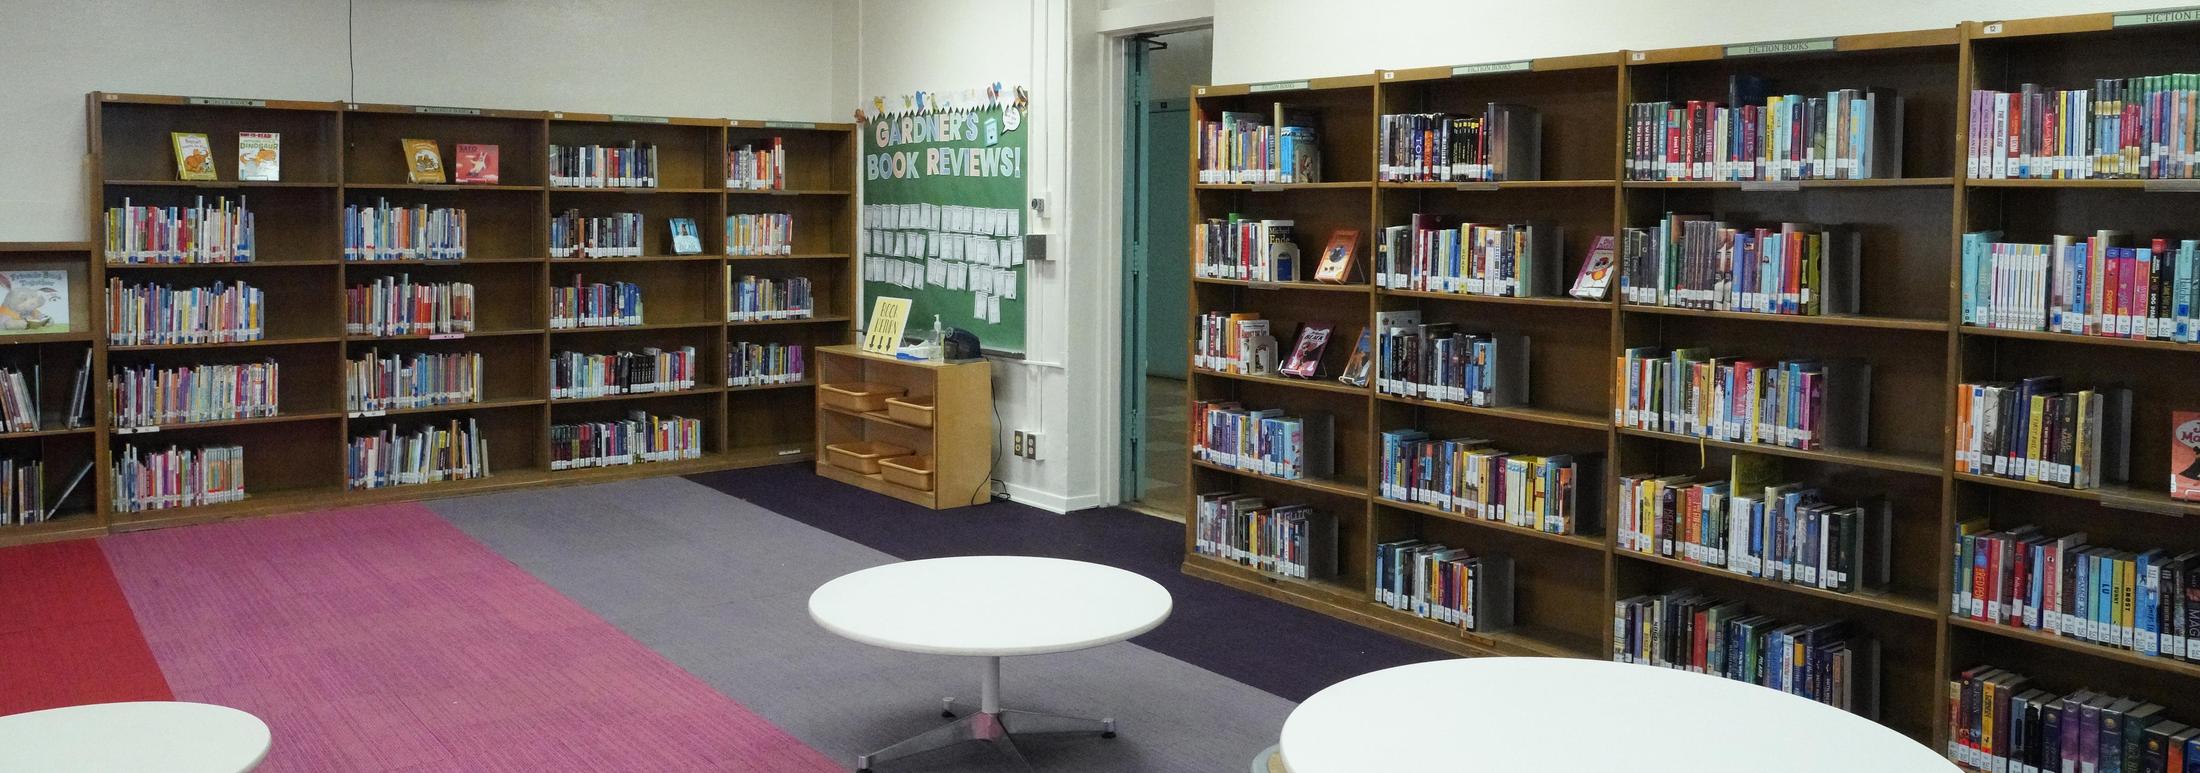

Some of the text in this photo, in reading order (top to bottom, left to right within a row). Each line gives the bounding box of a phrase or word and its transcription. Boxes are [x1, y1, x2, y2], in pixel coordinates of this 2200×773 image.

[2145, 11, 2194, 23] FICTION
[1748, 41, 1809, 53] FICTION BOOKS
[875, 112, 979, 147] GARDNER'S
[867, 146, 1021, 181] BOOK REVIEWS!
[1976, 572, 1986, 586] RED
[2102, 584, 2110, 594] LU
